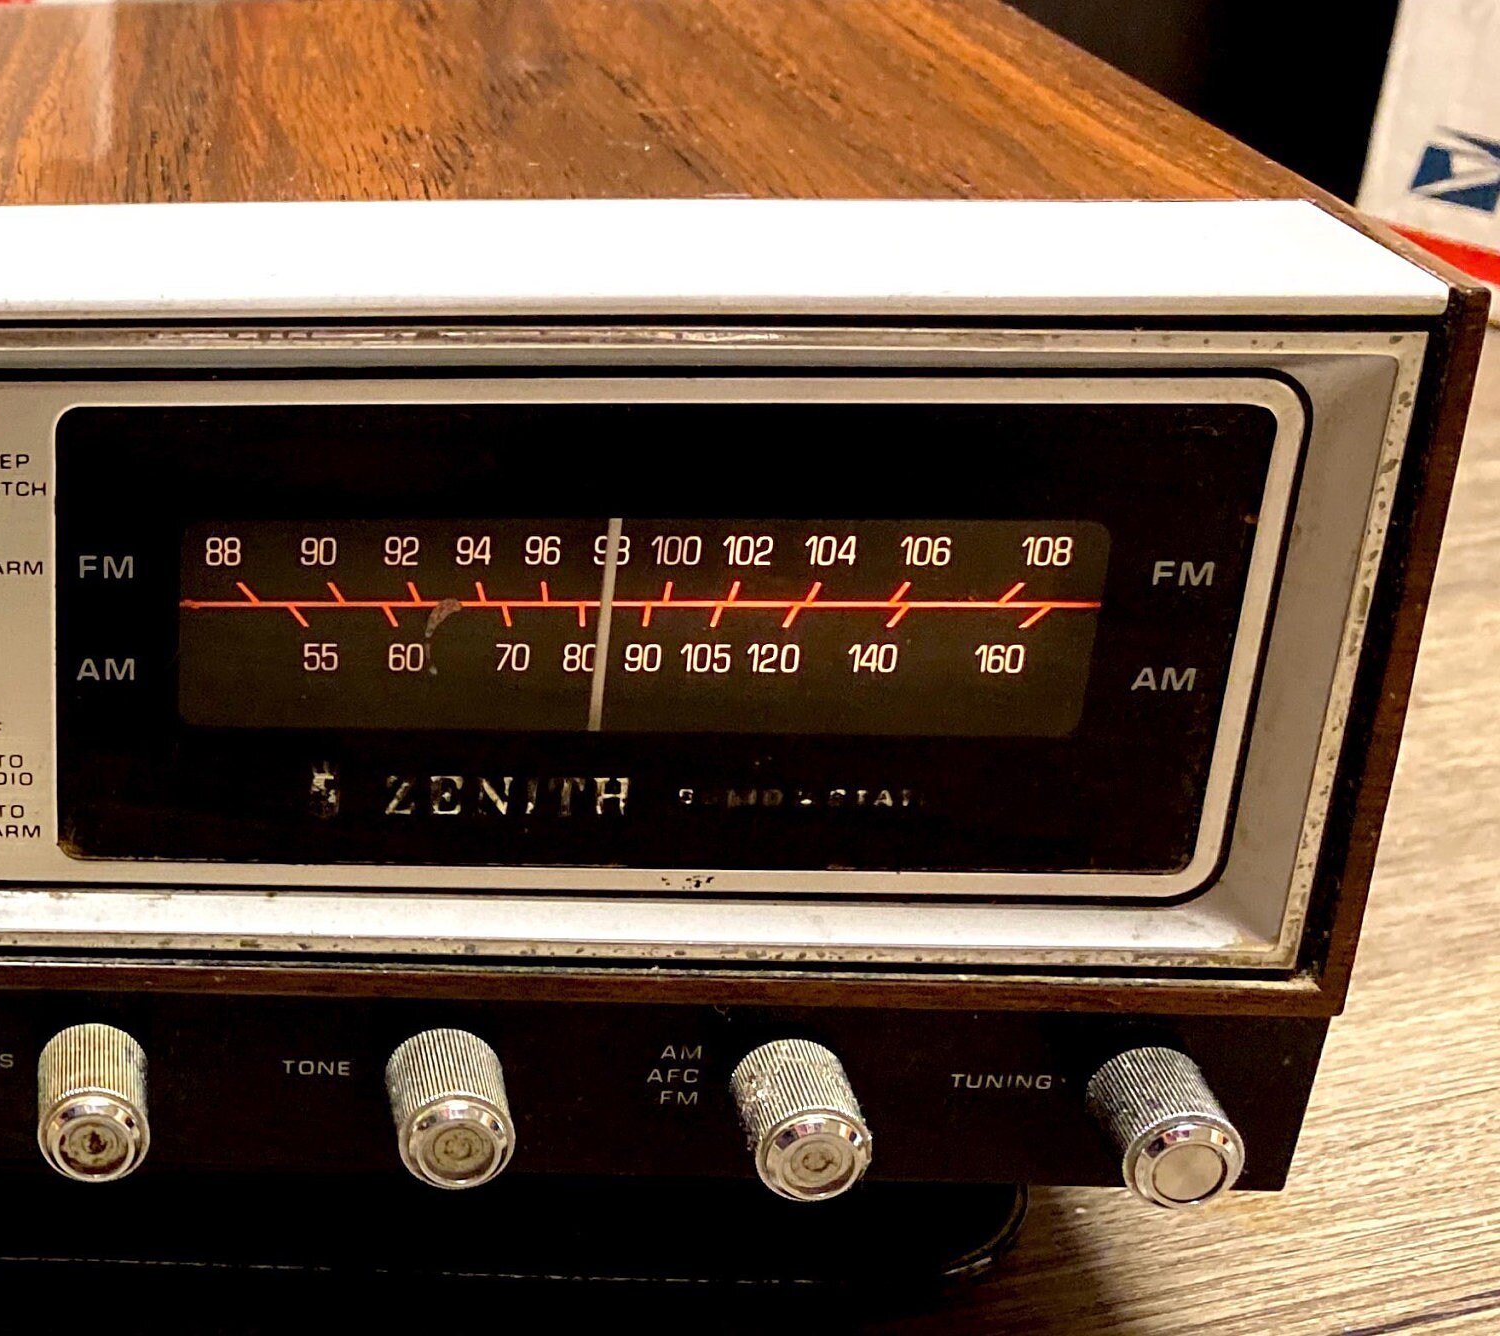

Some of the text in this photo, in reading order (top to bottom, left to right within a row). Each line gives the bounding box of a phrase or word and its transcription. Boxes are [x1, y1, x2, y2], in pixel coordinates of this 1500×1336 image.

[79, 535, 1216, 587] FM 88 90 92 94 96 98 100 102 104 106 108 FM
[76, 643, 1197, 692] AM 55 60 70 80 90 105 120 140 160 AM
[385, 775, 629, 815] ZENITH
[660, 1045, 702, 1060] AM
[282, 1060, 350, 1076] TONE
[646, 1068, 699, 1084] AFC
[951, 1073, 1052, 1090] TUNING
[659, 1090, 698, 1105] FM
